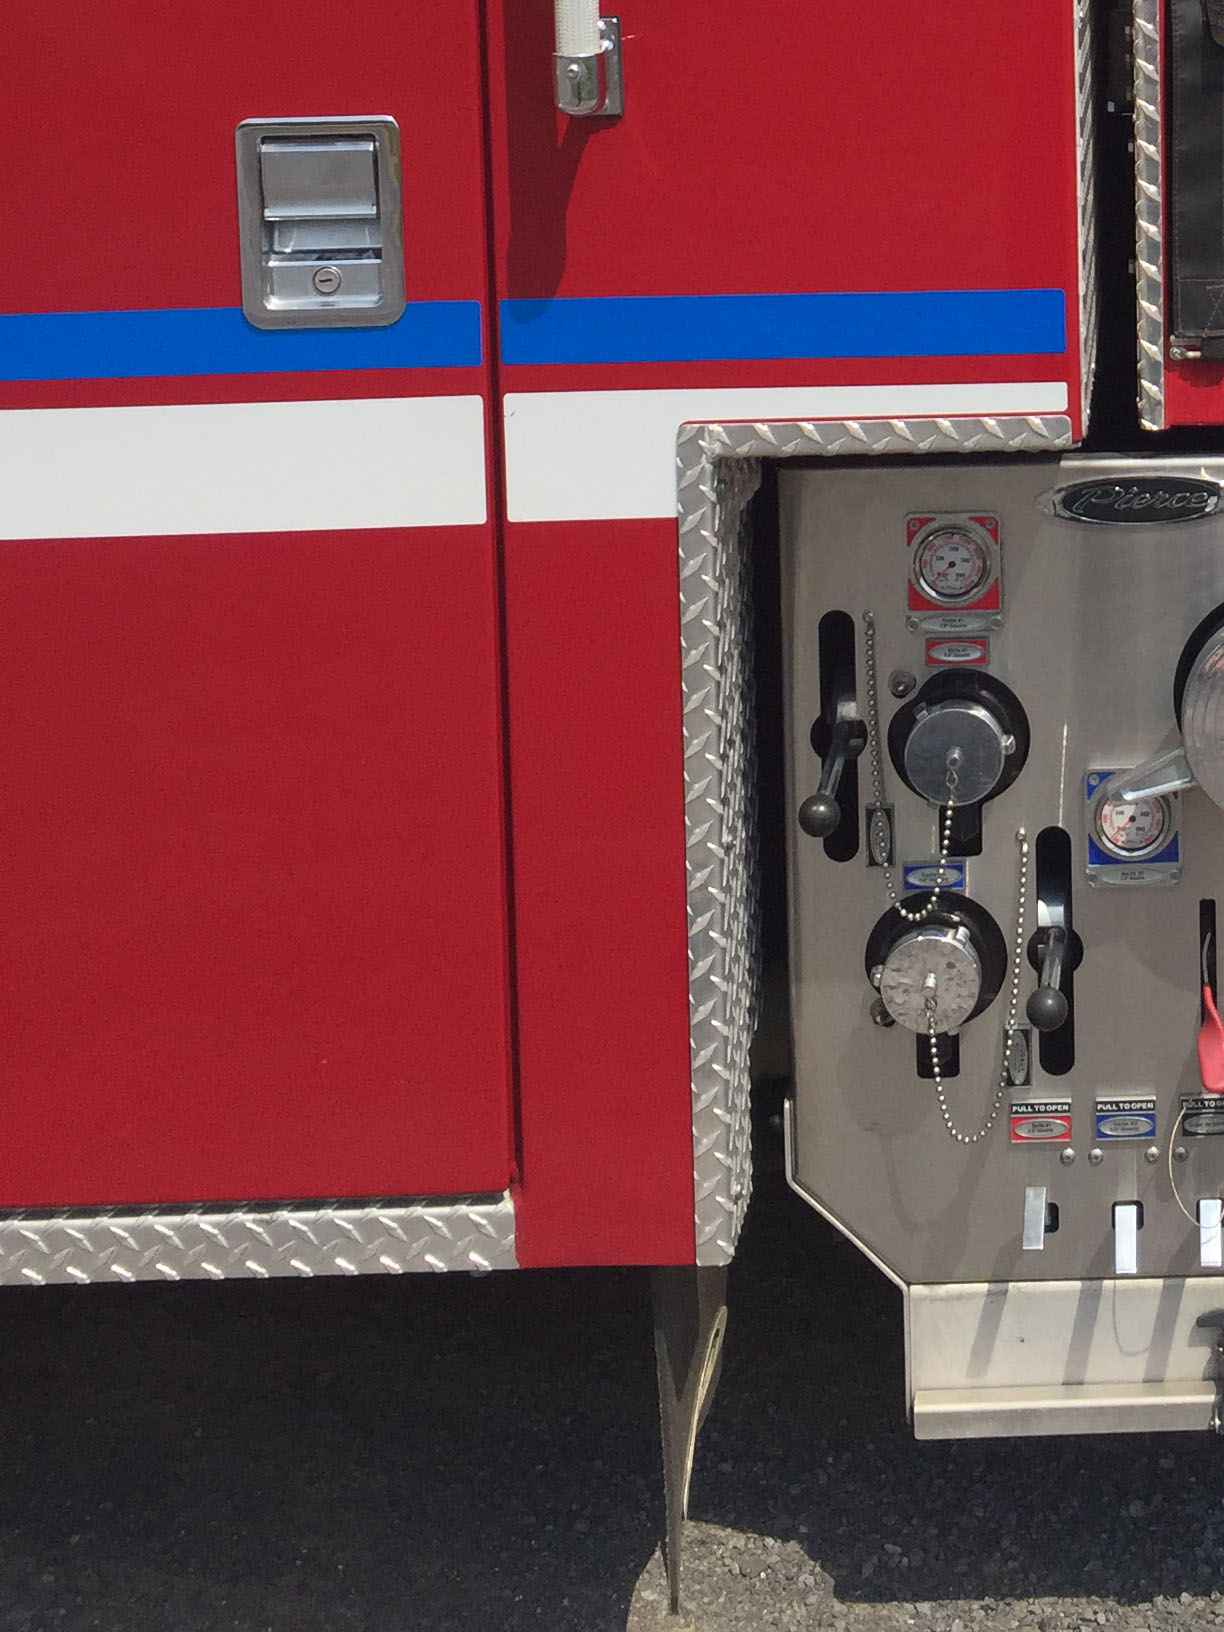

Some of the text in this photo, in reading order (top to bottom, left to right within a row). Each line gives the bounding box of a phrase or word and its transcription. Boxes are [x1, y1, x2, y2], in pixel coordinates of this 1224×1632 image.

[1072, 485, 1211, 514] Pierce
[1012, 1104, 1069, 1113] PULL TO OPEN
[1096, 1103, 1118, 1111] PULL
[1131, 1102, 1154, 1110] OPEN
[1203, 1100, 1216, 1108] TO
